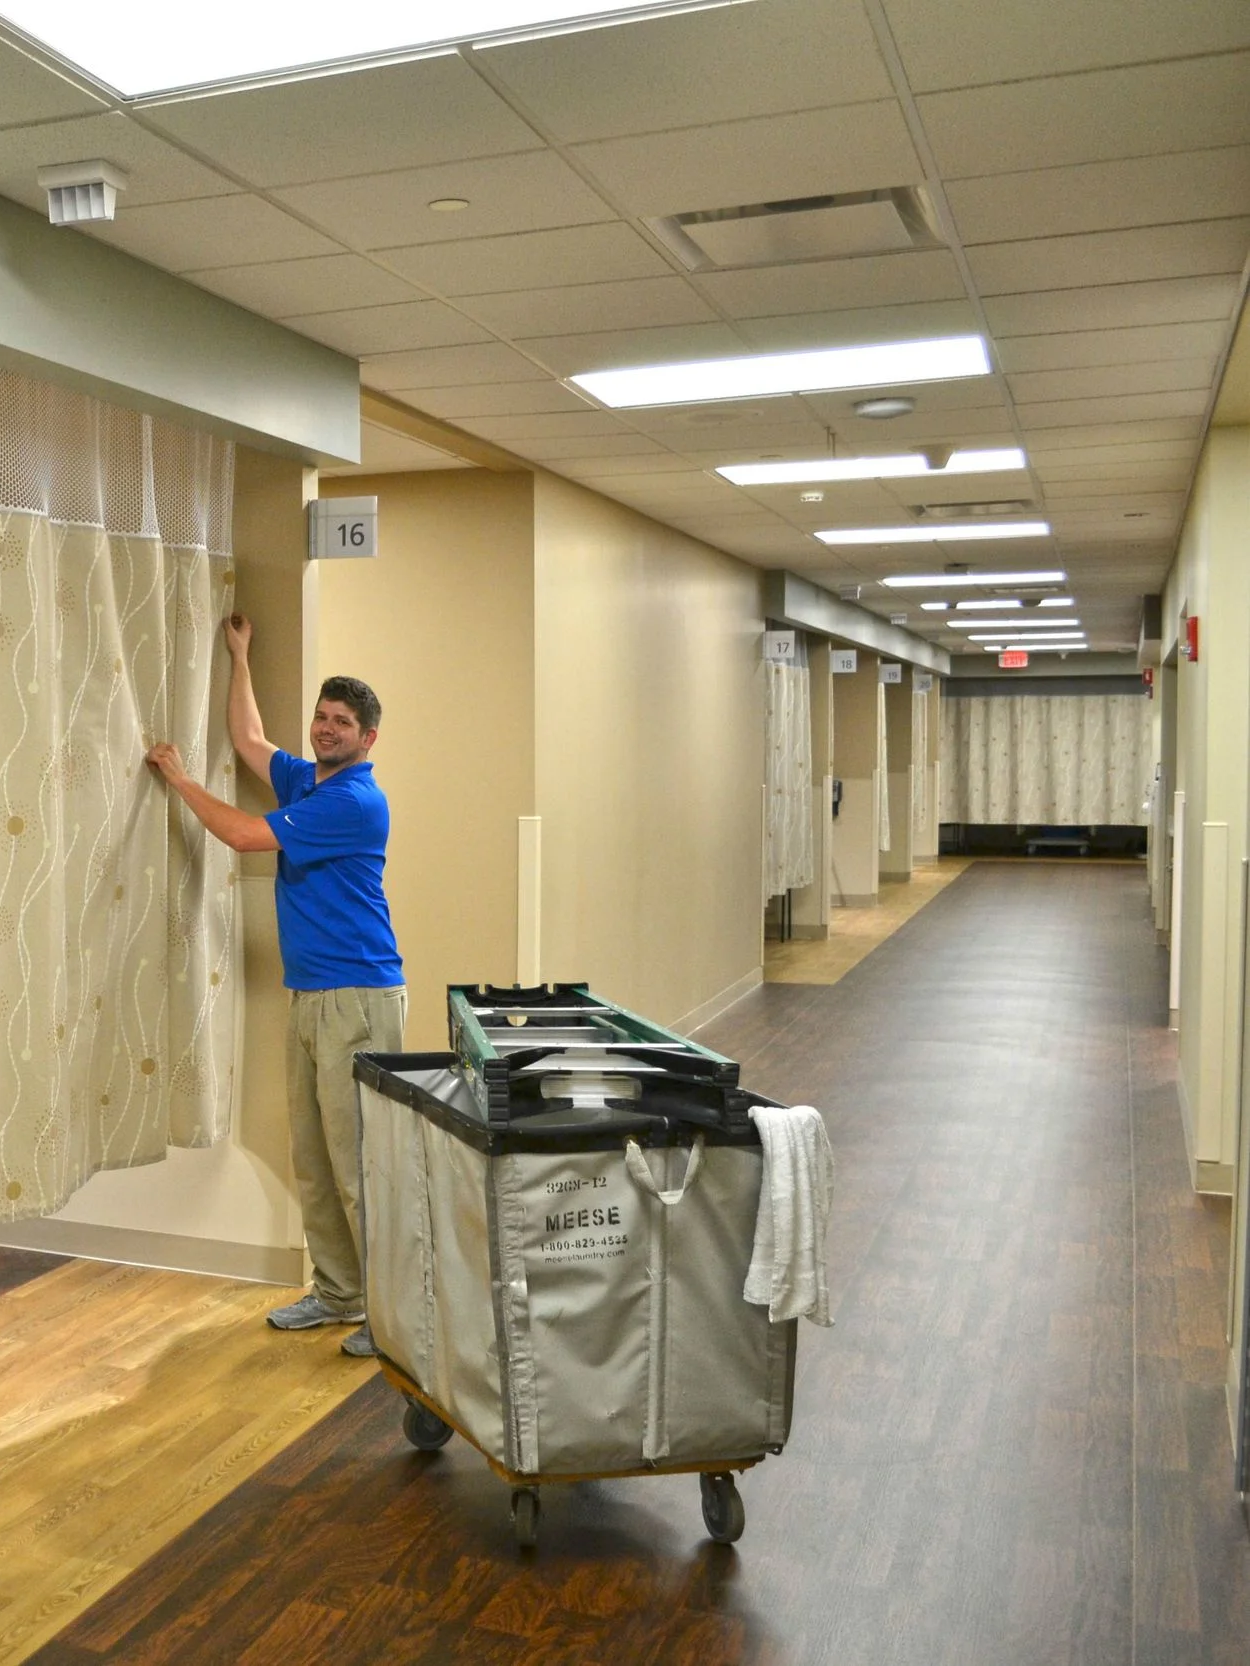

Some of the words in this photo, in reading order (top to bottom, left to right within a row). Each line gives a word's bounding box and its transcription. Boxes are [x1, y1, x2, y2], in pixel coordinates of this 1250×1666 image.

[337, 522, 365, 547] 16
[776, 642, 790, 654] 17
[841, 659, 853, 670] 18
[1003, 653, 1026, 665] EXIT
[545, 1206, 621, 1232] MEESE
